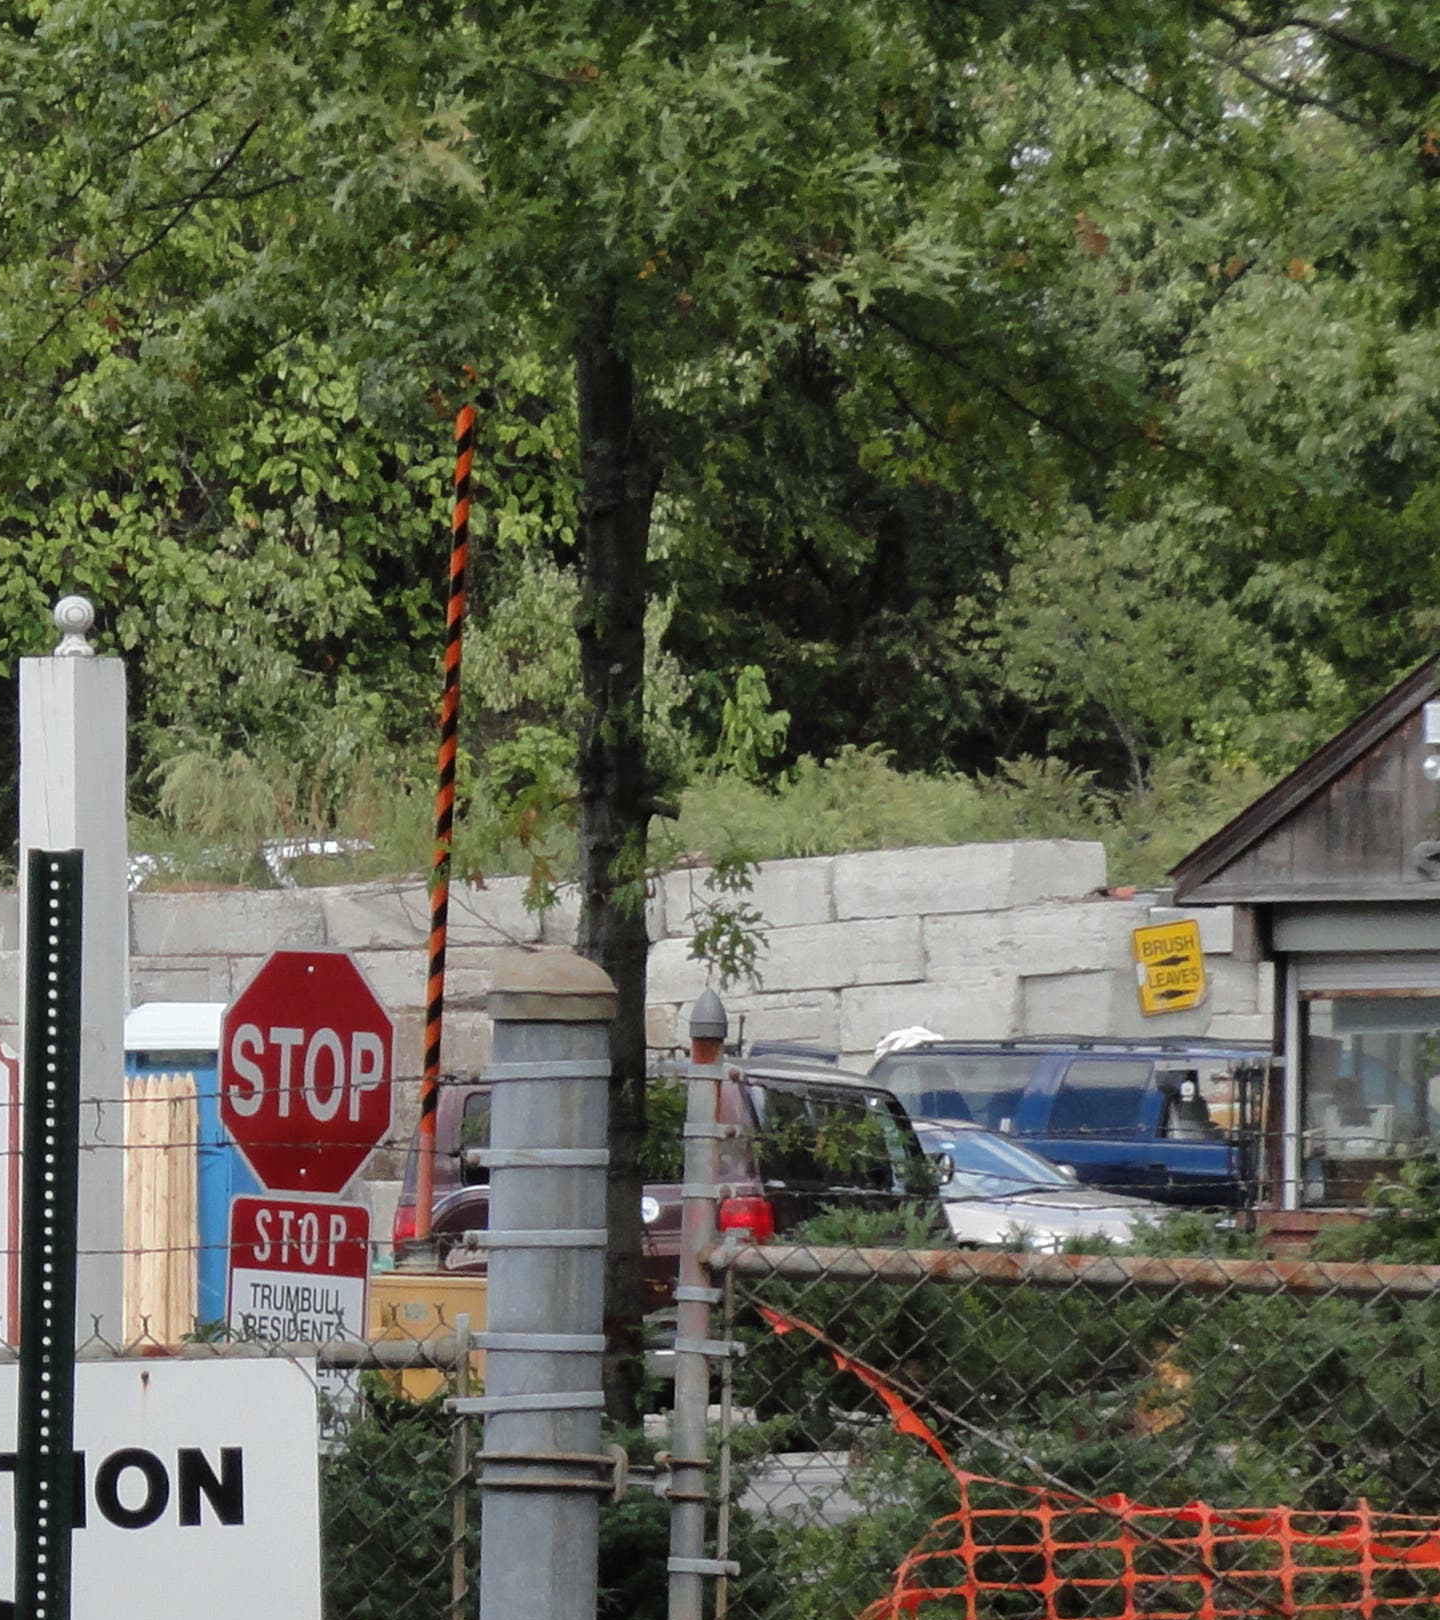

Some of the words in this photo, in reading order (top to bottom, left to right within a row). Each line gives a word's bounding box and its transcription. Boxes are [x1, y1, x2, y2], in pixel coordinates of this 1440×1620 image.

[1142, 935, 1195, 957] BRUSH
[1148, 967, 1200, 989] LEAVES
[229, 1023, 384, 1122] STOP
[253, 1208, 347, 1267] STOP
[250, 1282, 340, 1316] TRUMBULL
